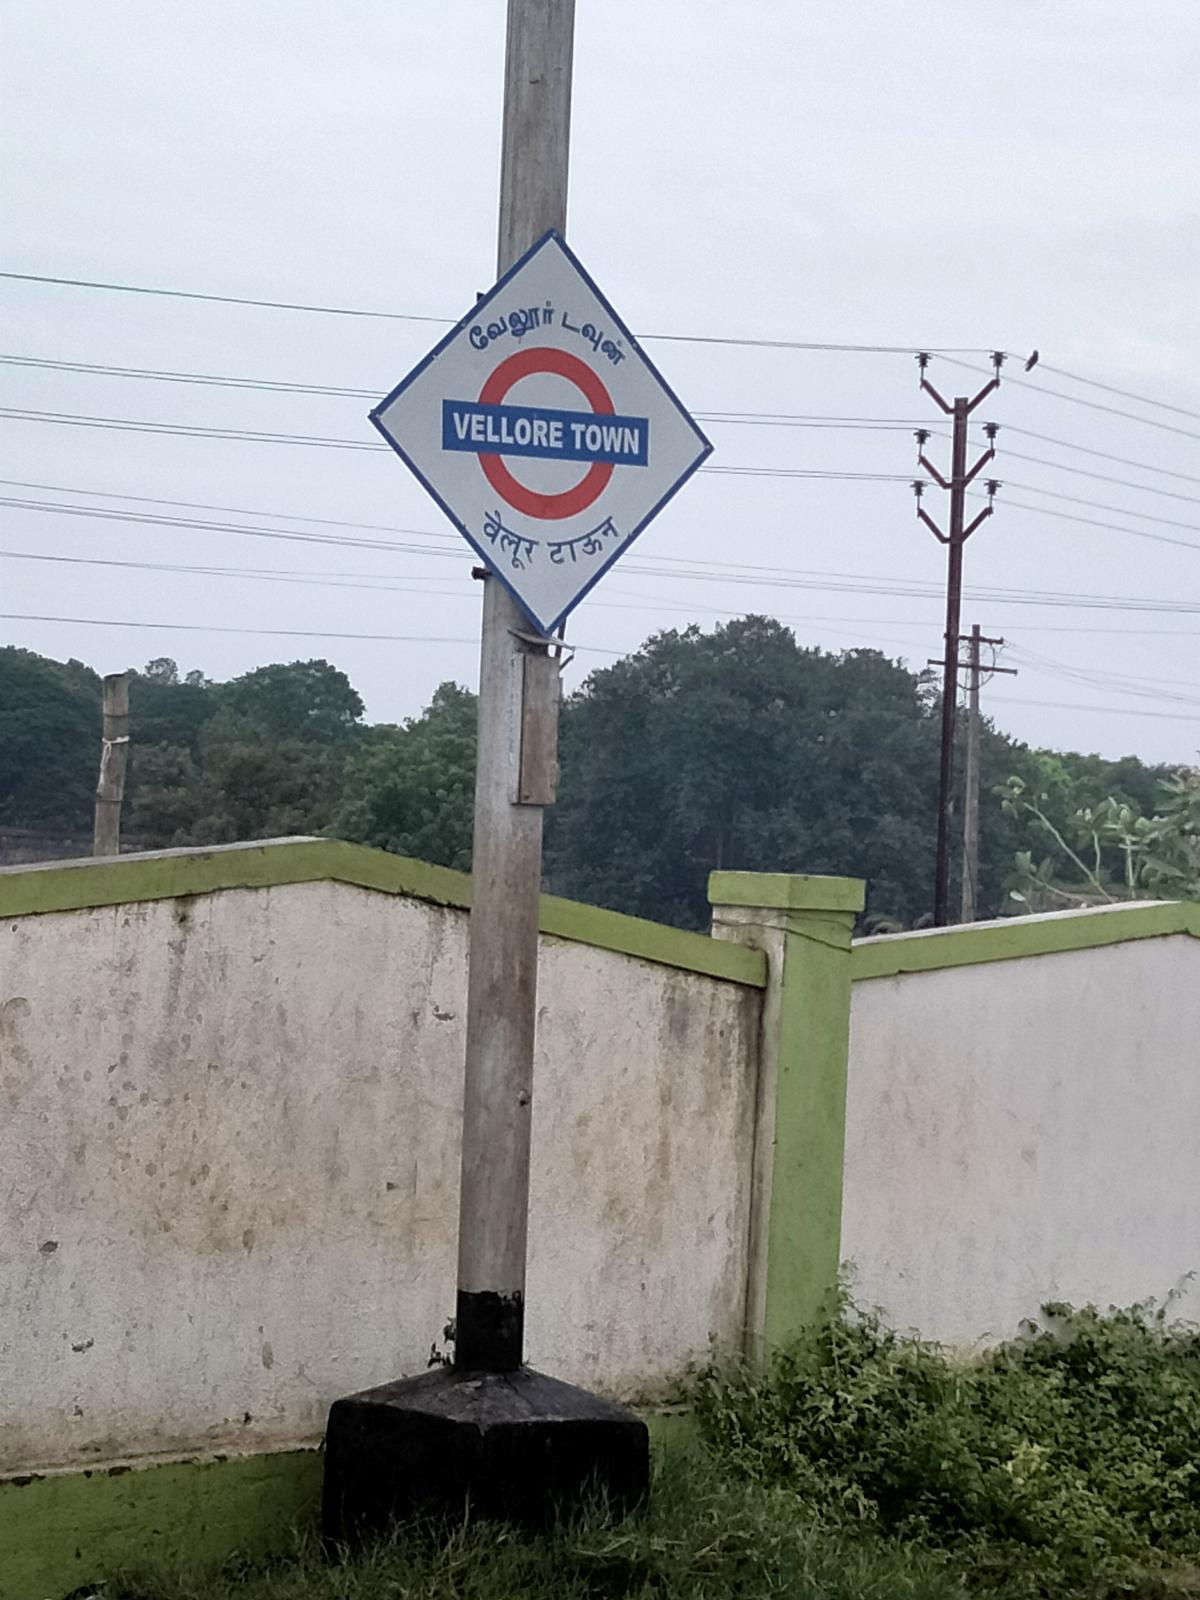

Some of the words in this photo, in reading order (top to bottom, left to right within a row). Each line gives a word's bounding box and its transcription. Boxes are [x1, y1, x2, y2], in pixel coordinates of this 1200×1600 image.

[469, 301, 554, 349] வேலூர்
[561, 312, 625, 365] டவுன்
[453, 412, 563, 448] VELLORE
[571, 423, 639, 454] TOWN
[484, 510, 539, 570] वेलूर
[547, 516, 619, 564] टाऊन
